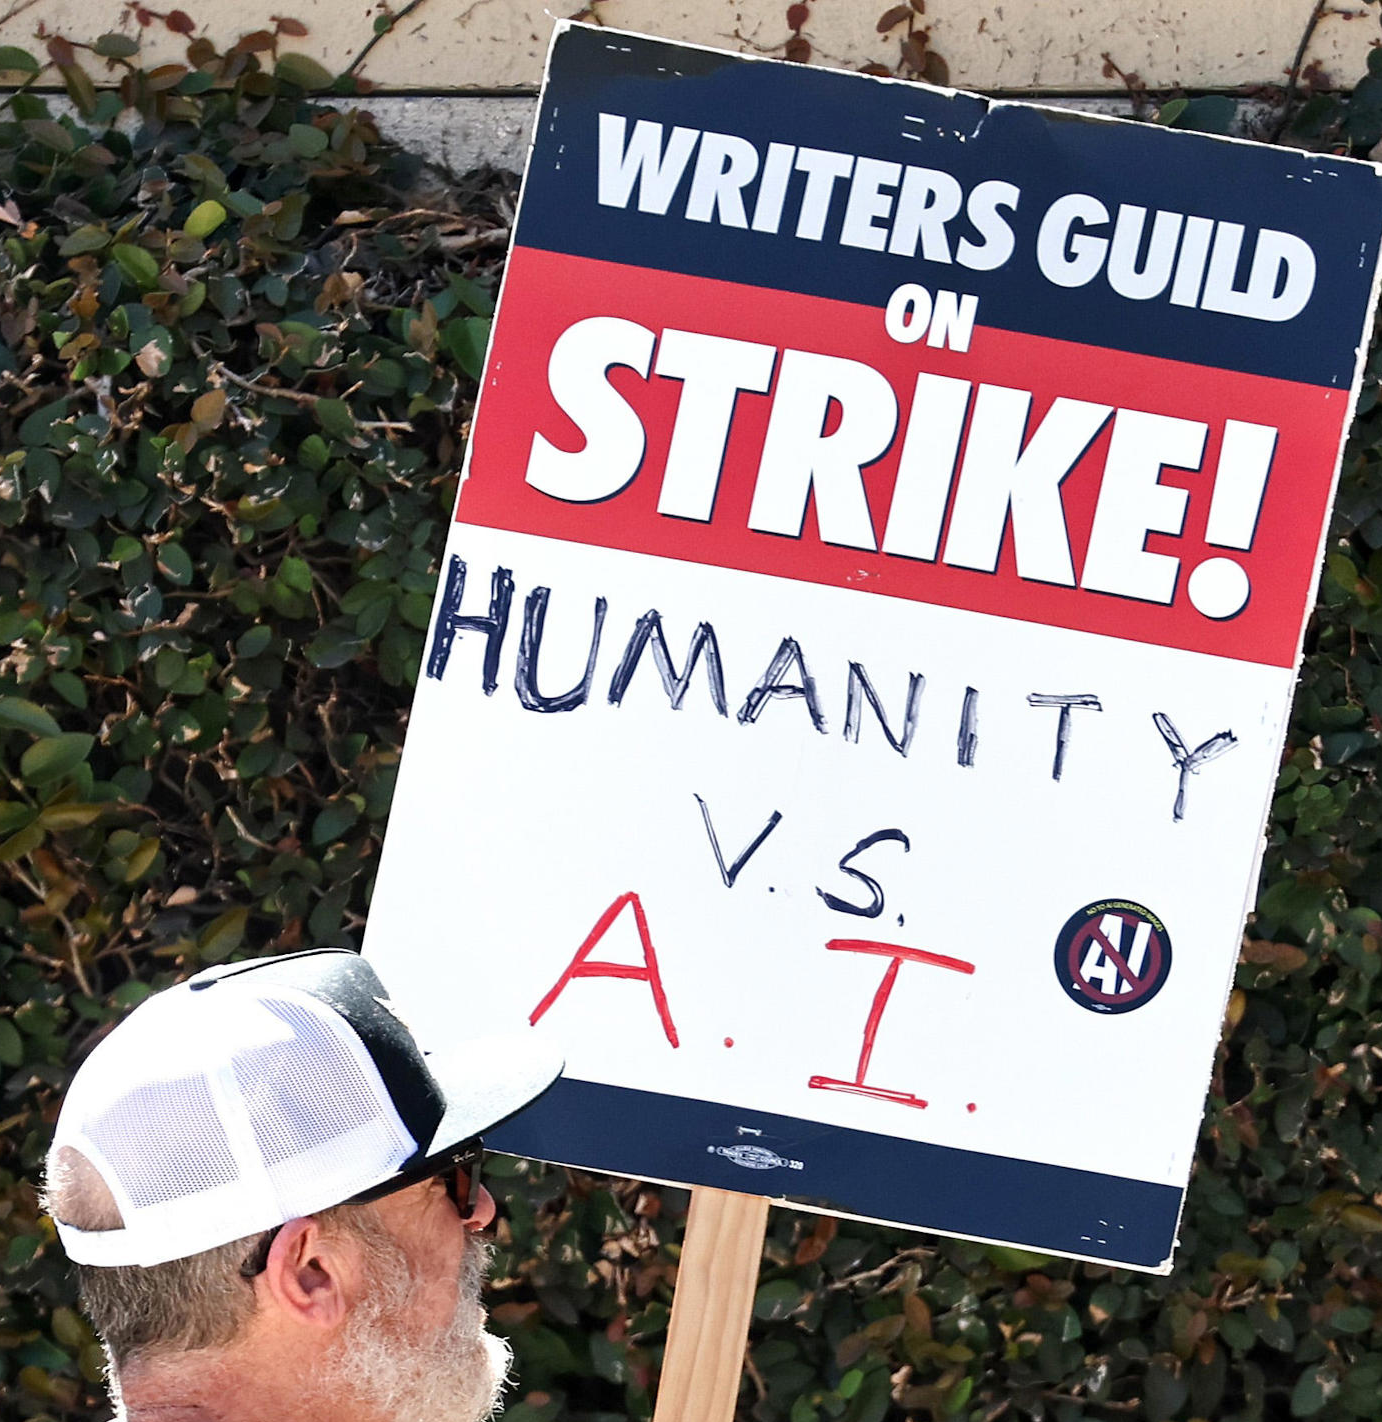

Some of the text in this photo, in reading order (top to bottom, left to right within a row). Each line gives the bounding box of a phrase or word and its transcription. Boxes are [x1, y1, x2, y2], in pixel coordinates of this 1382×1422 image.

[597, 112, 1317, 323] WRITERS GUILD
[884, 282, 980, 354] ON
[524, 315, 1279, 621] STRIKE!
[425, 552, 1239, 821] HUMANITY
[1072, 913, 1153, 995] AI
